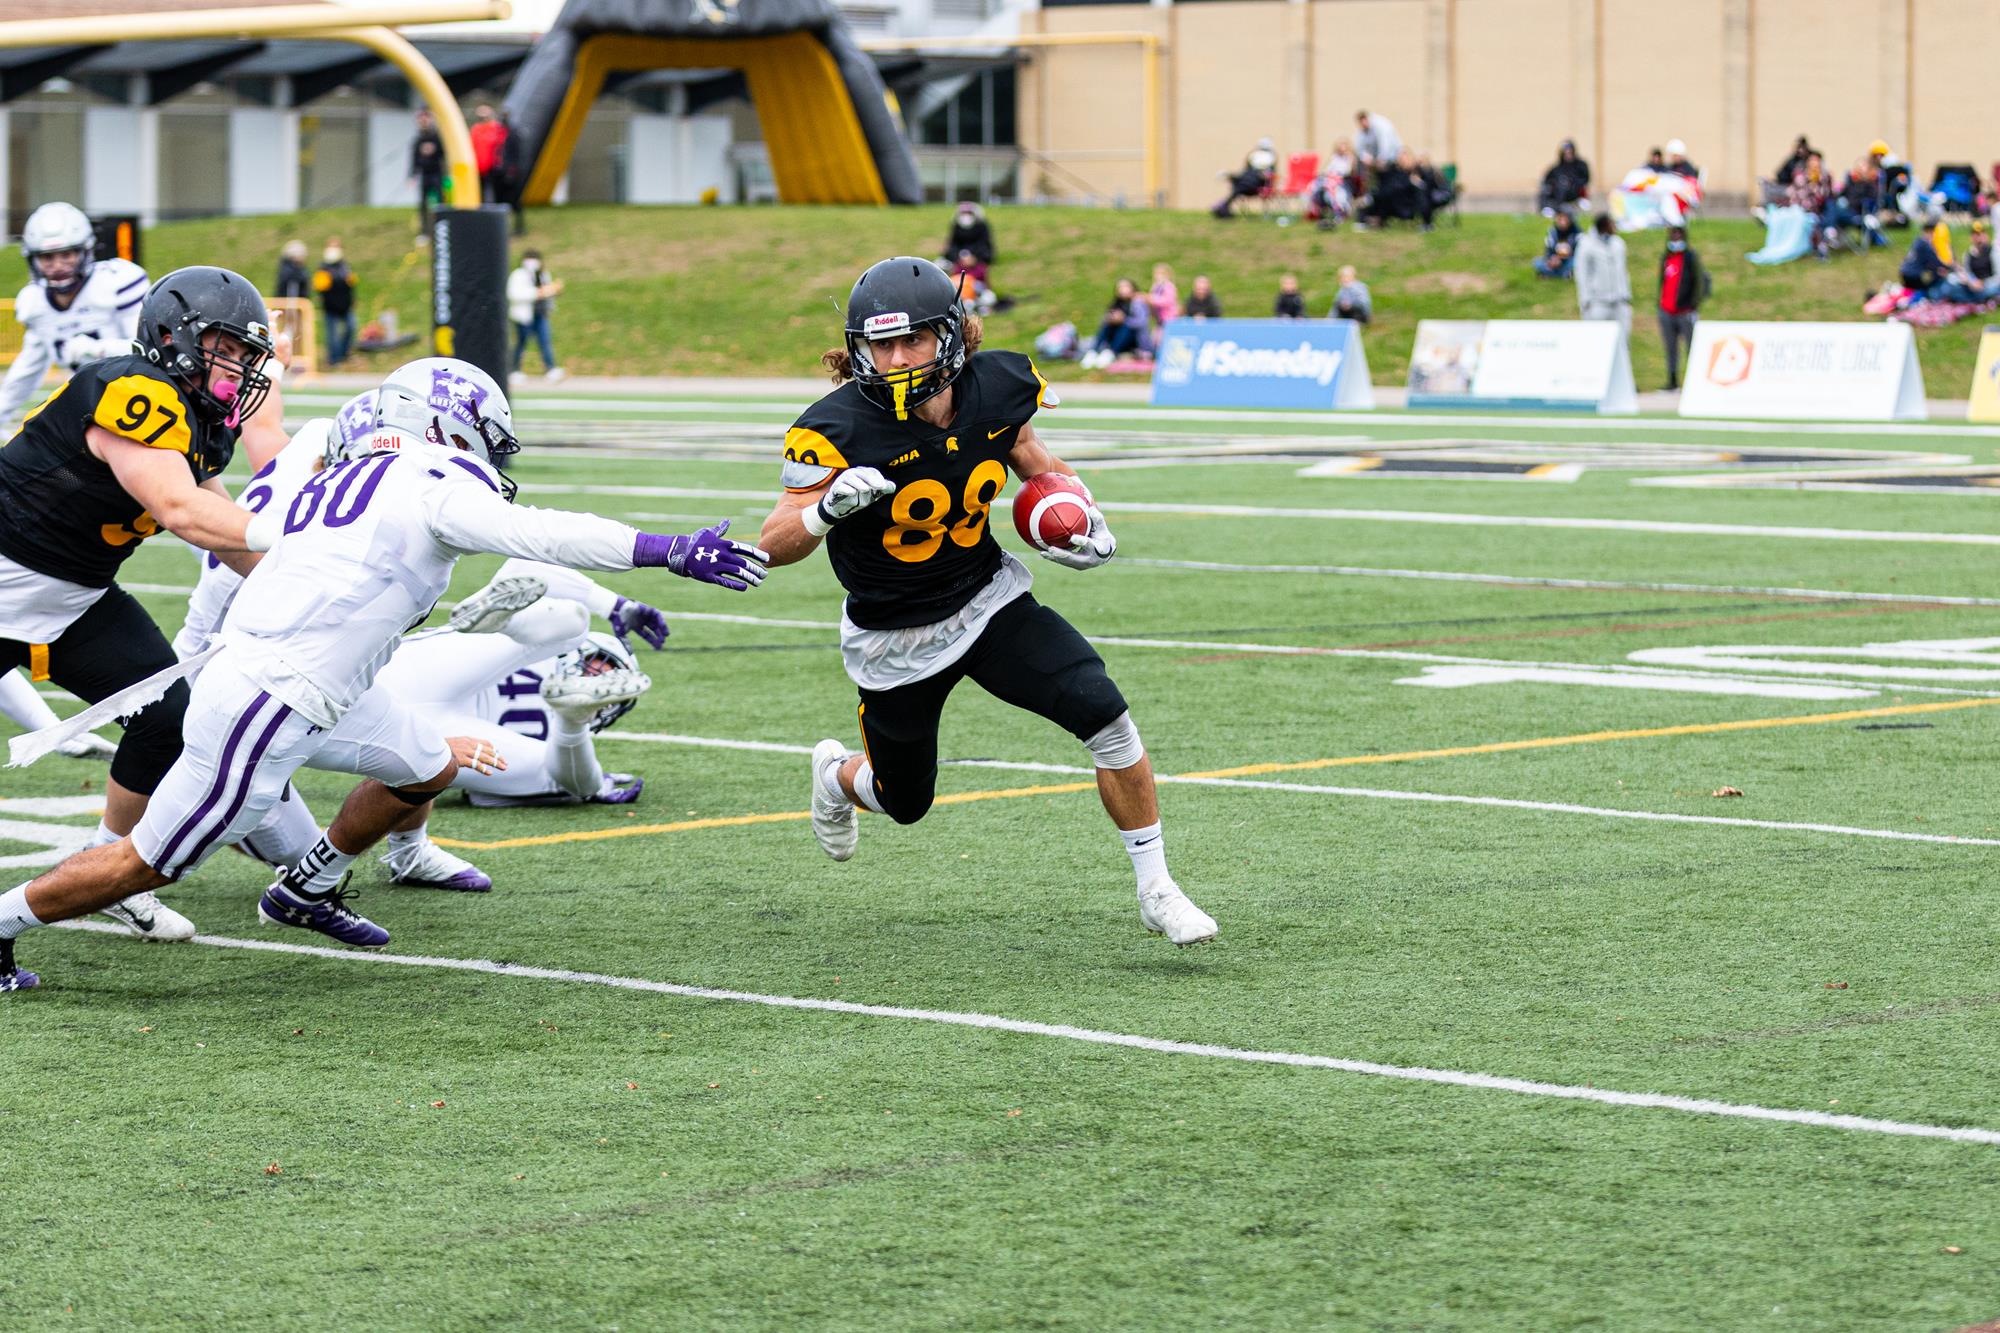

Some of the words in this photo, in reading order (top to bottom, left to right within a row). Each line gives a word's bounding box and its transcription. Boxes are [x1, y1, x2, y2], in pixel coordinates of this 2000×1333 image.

[874, 315, 899, 325] Riddell
[1196, 341, 1342, 386] #Someday
[115, 394, 178, 445] 97
[284, 454, 400, 536] 80
